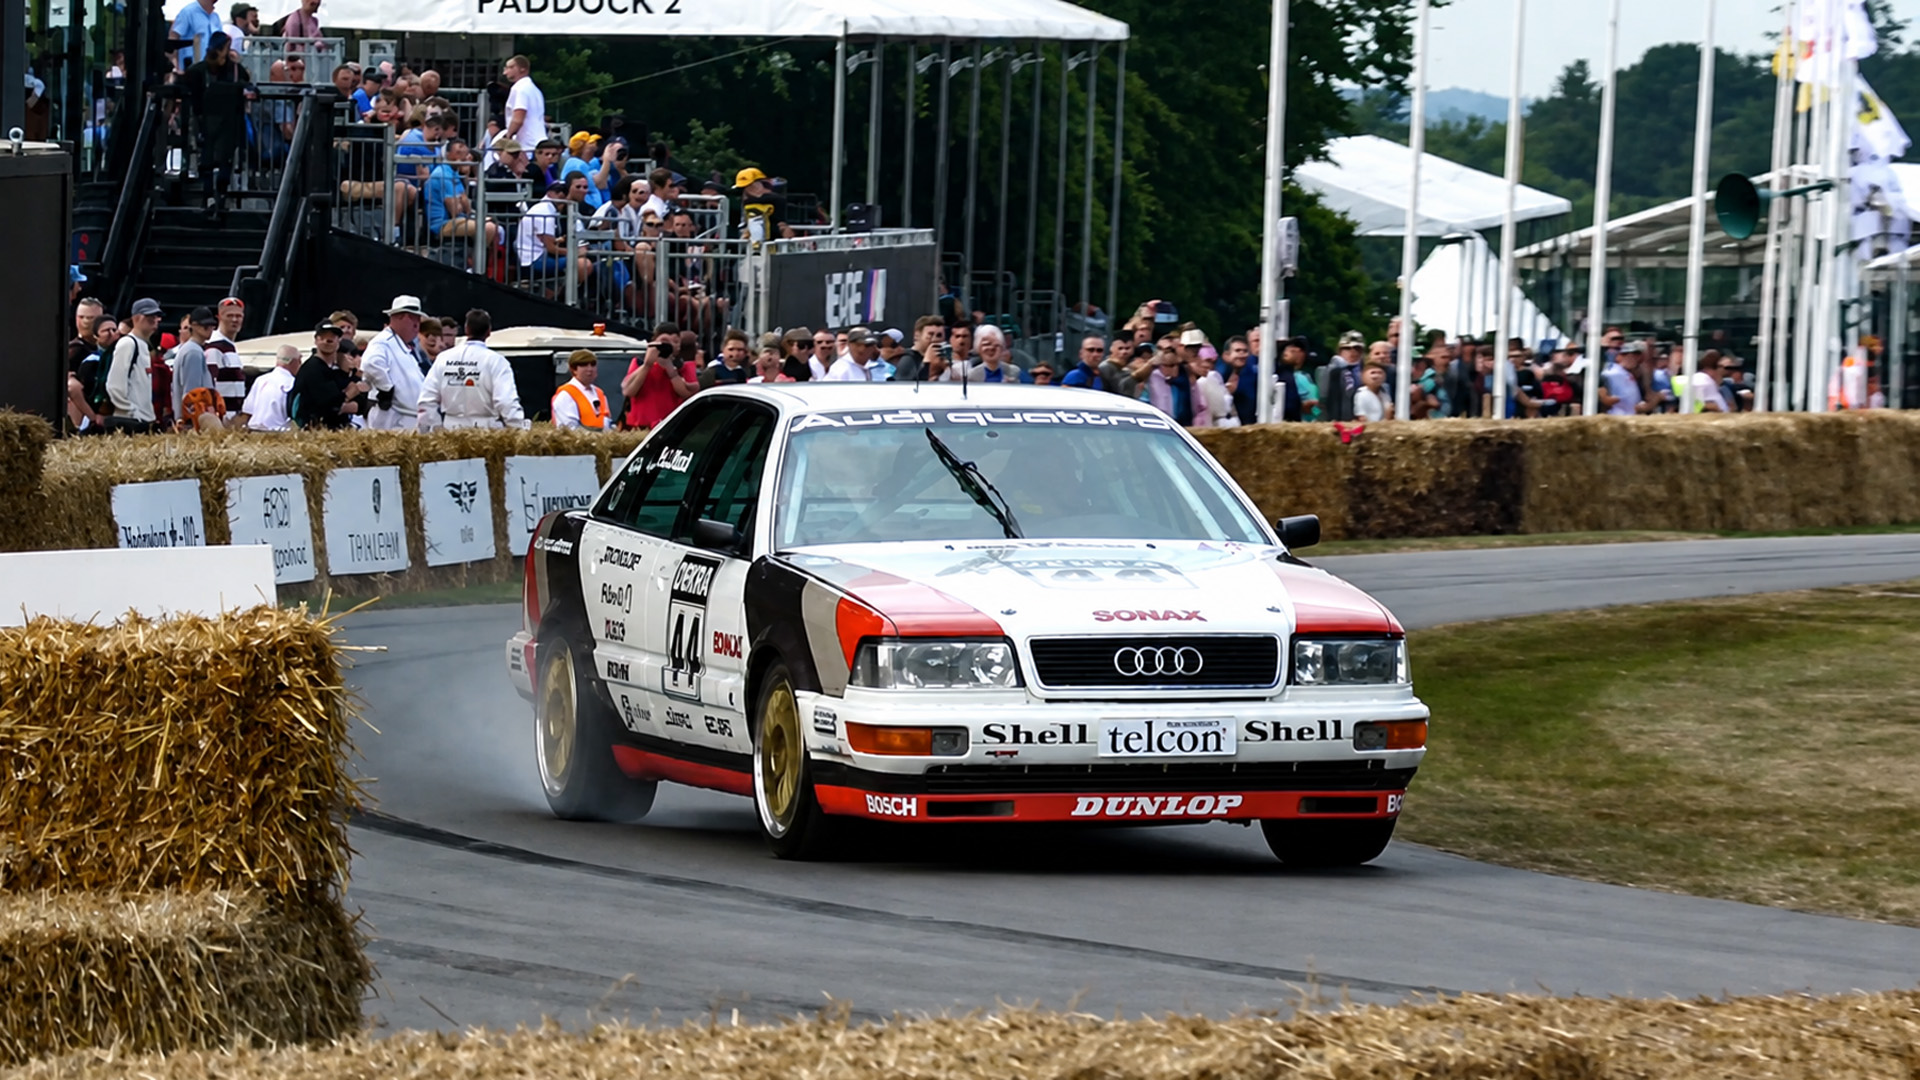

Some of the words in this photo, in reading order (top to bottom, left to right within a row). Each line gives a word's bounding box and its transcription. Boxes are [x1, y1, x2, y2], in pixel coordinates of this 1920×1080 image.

[478, 0, 653, 14] PADDOCK
[664, 0, 682, 14] 2
[790, 410, 936, 432] Audi
[946, 410, 1171, 431] quattro
[673, 561, 713, 597] DEKRA
[1092, 609, 1208, 622] SONAX
[671, 609, 703, 689] 44
[982, 722, 1090, 745] Shell
[1107, 720, 1223, 754] telcon
[1243, 719, 1344, 742] Shell
[865, 793, 918, 817] BOSCH
[1071, 795, 1243, 816] DUNLOP
